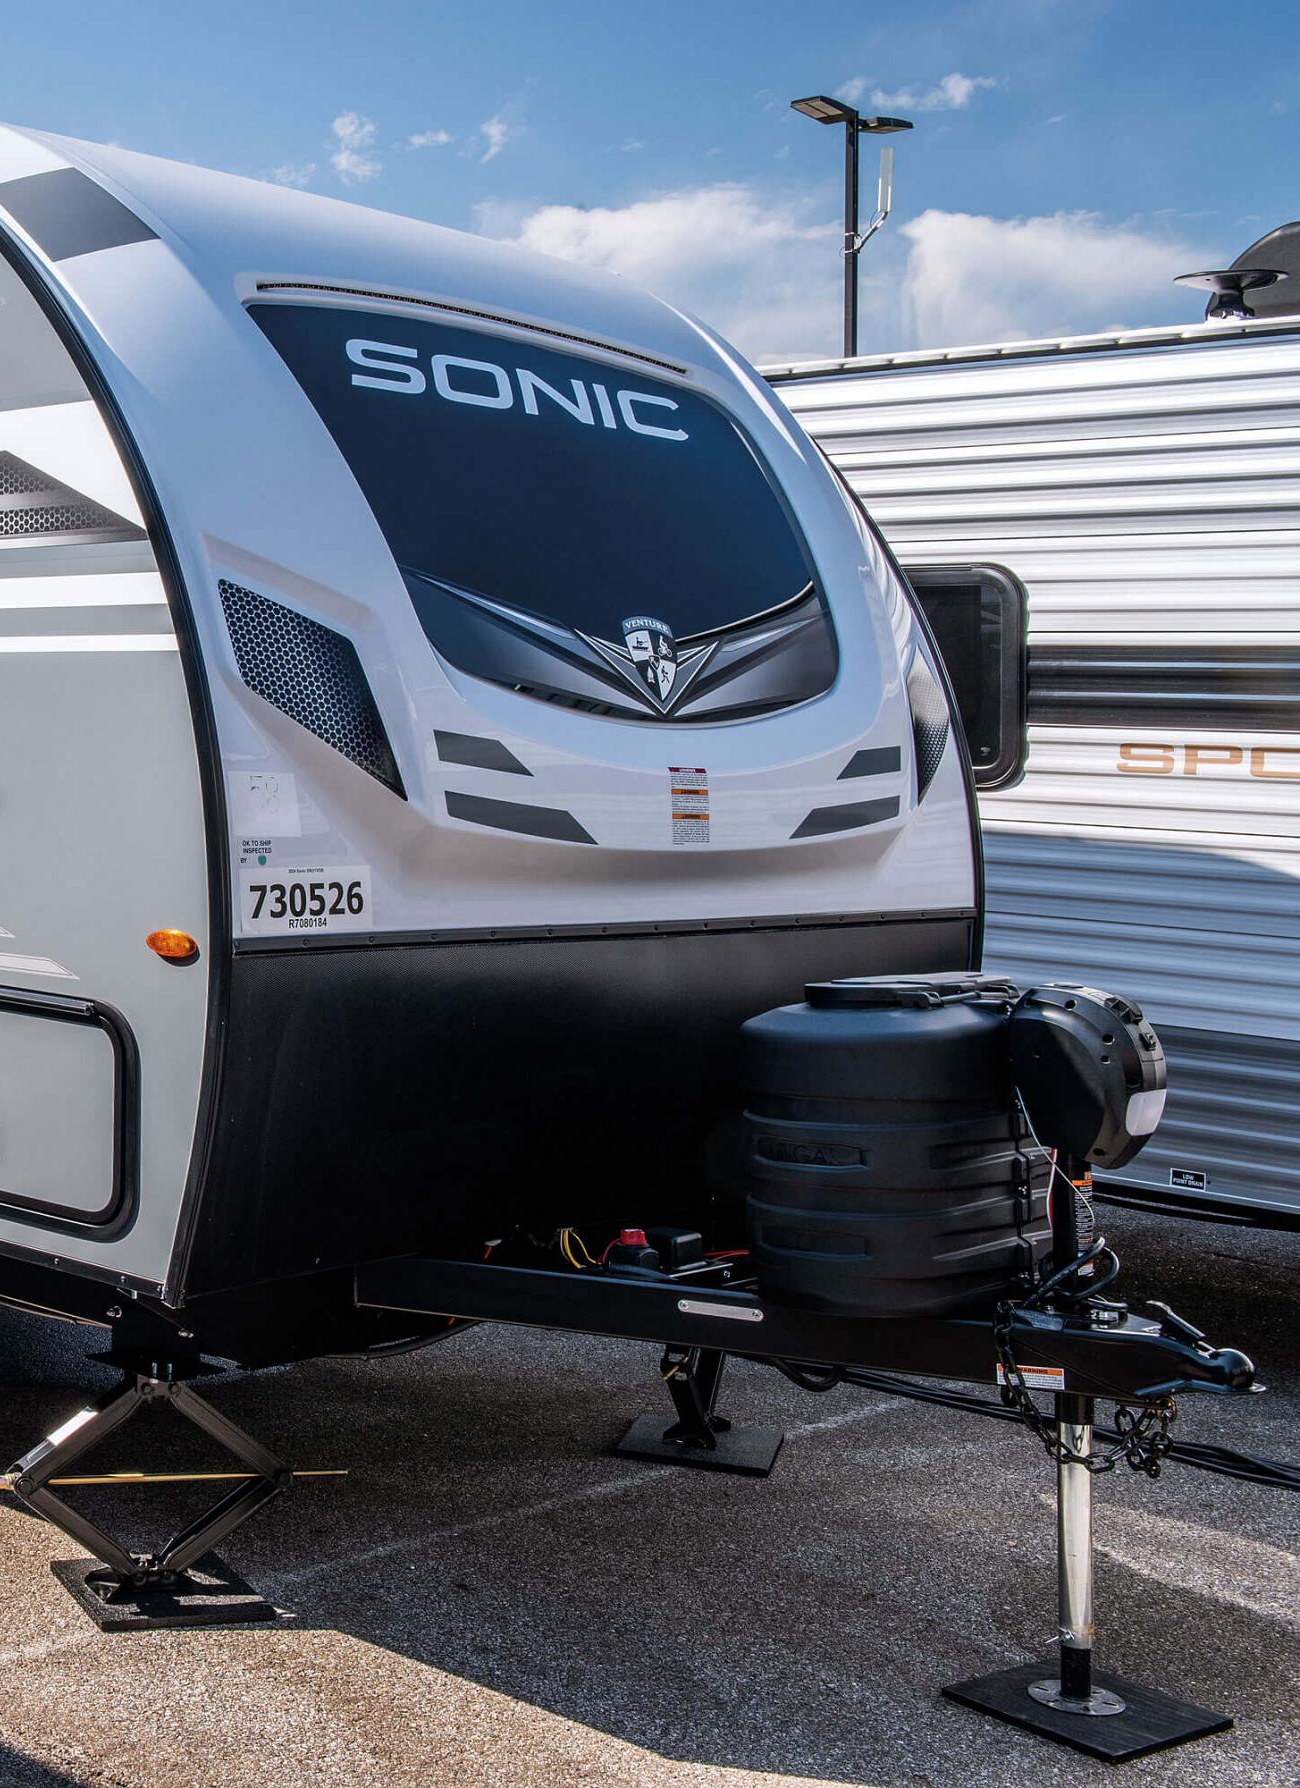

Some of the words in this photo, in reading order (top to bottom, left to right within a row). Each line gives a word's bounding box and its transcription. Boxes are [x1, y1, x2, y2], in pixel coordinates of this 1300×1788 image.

[345, 338, 689, 442] SONIC
[624, 618, 669, 634] VENTURE
[249, 881, 364, 919] 730526
[288, 918, 328, 929] R7080184
